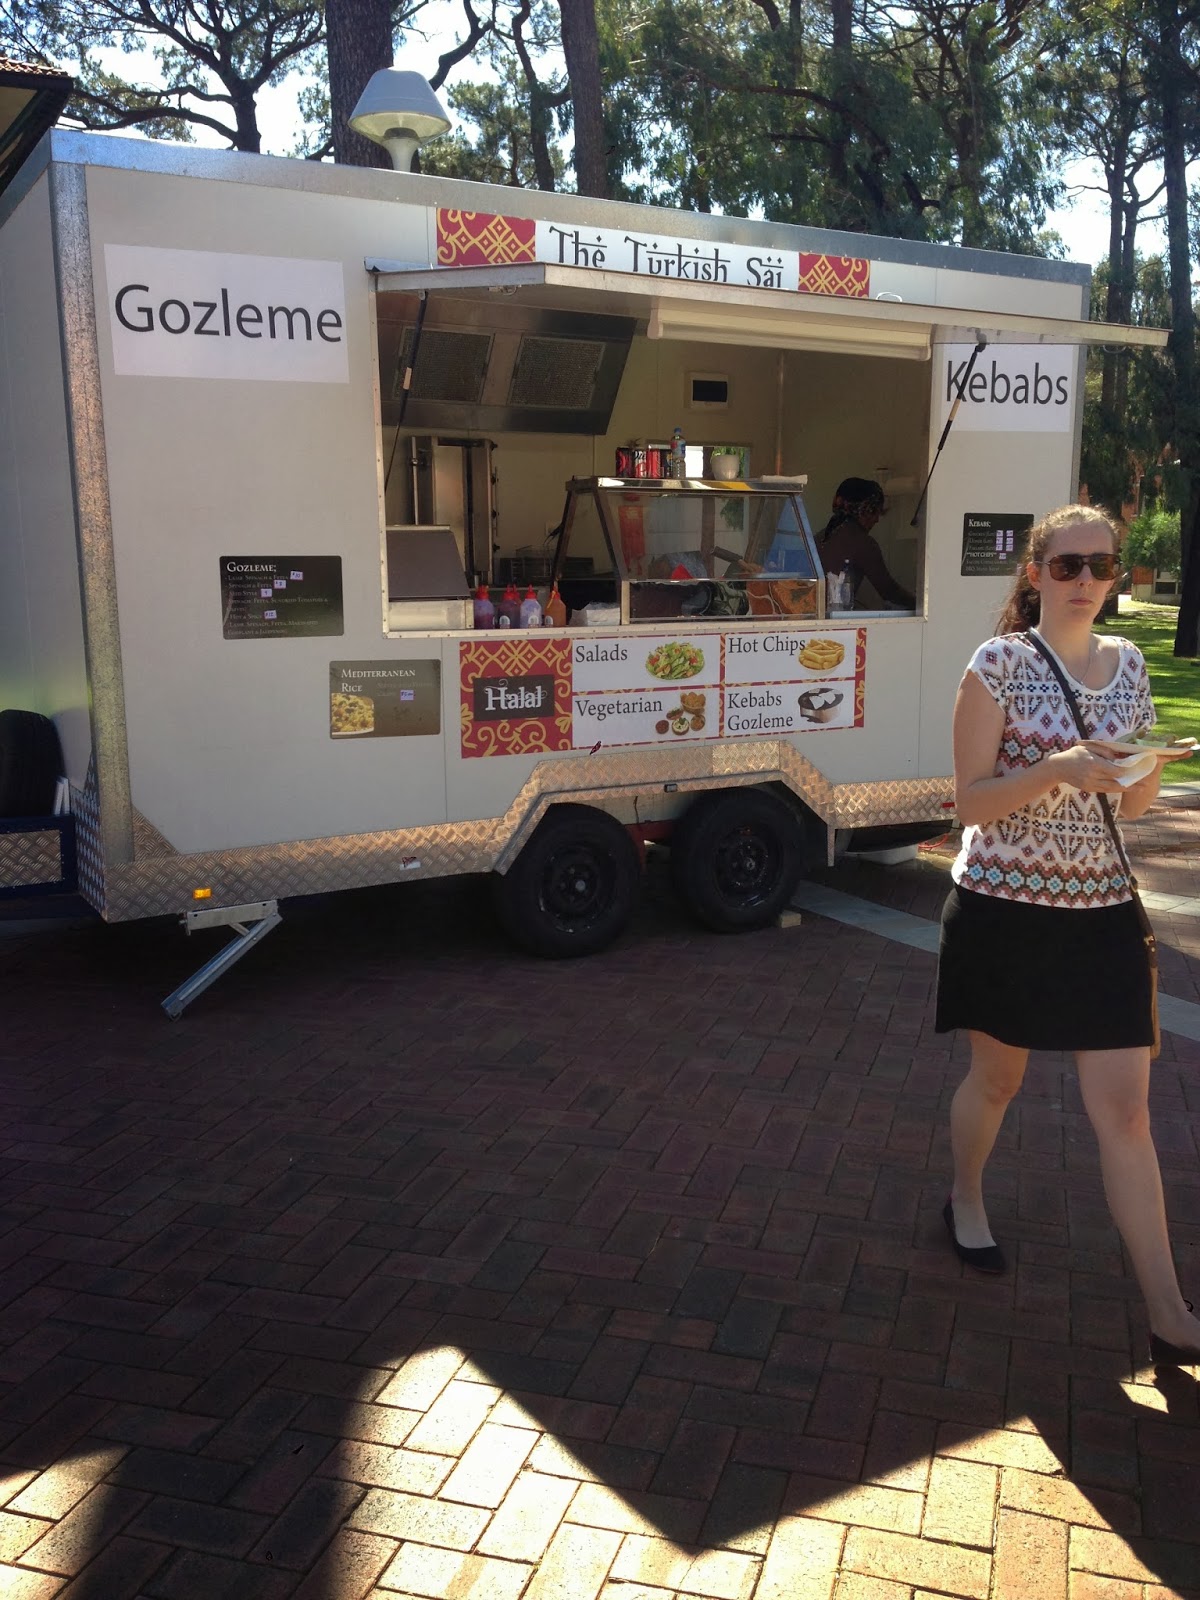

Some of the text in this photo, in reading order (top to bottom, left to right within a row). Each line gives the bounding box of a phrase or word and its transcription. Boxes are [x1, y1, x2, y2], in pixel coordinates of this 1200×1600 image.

[549, 226, 607, 268] The
[624, 236, 730, 282] Turkish
[115, 284, 342, 342] Gozleme
[946, 360, 1068, 405] Kebabs
[575, 644, 628, 663] Salads
[728, 635, 806, 656] Hot Chips
[341, 669, 416, 678] MEDITERRANEAN
[341, 682, 363, 692] RICE
[484, 679, 548, 711] Halal
[574, 697, 664, 721] Vegetarian
[727, 690, 783, 709] Kebabs
[727, 713, 794, 731] Gozleme
